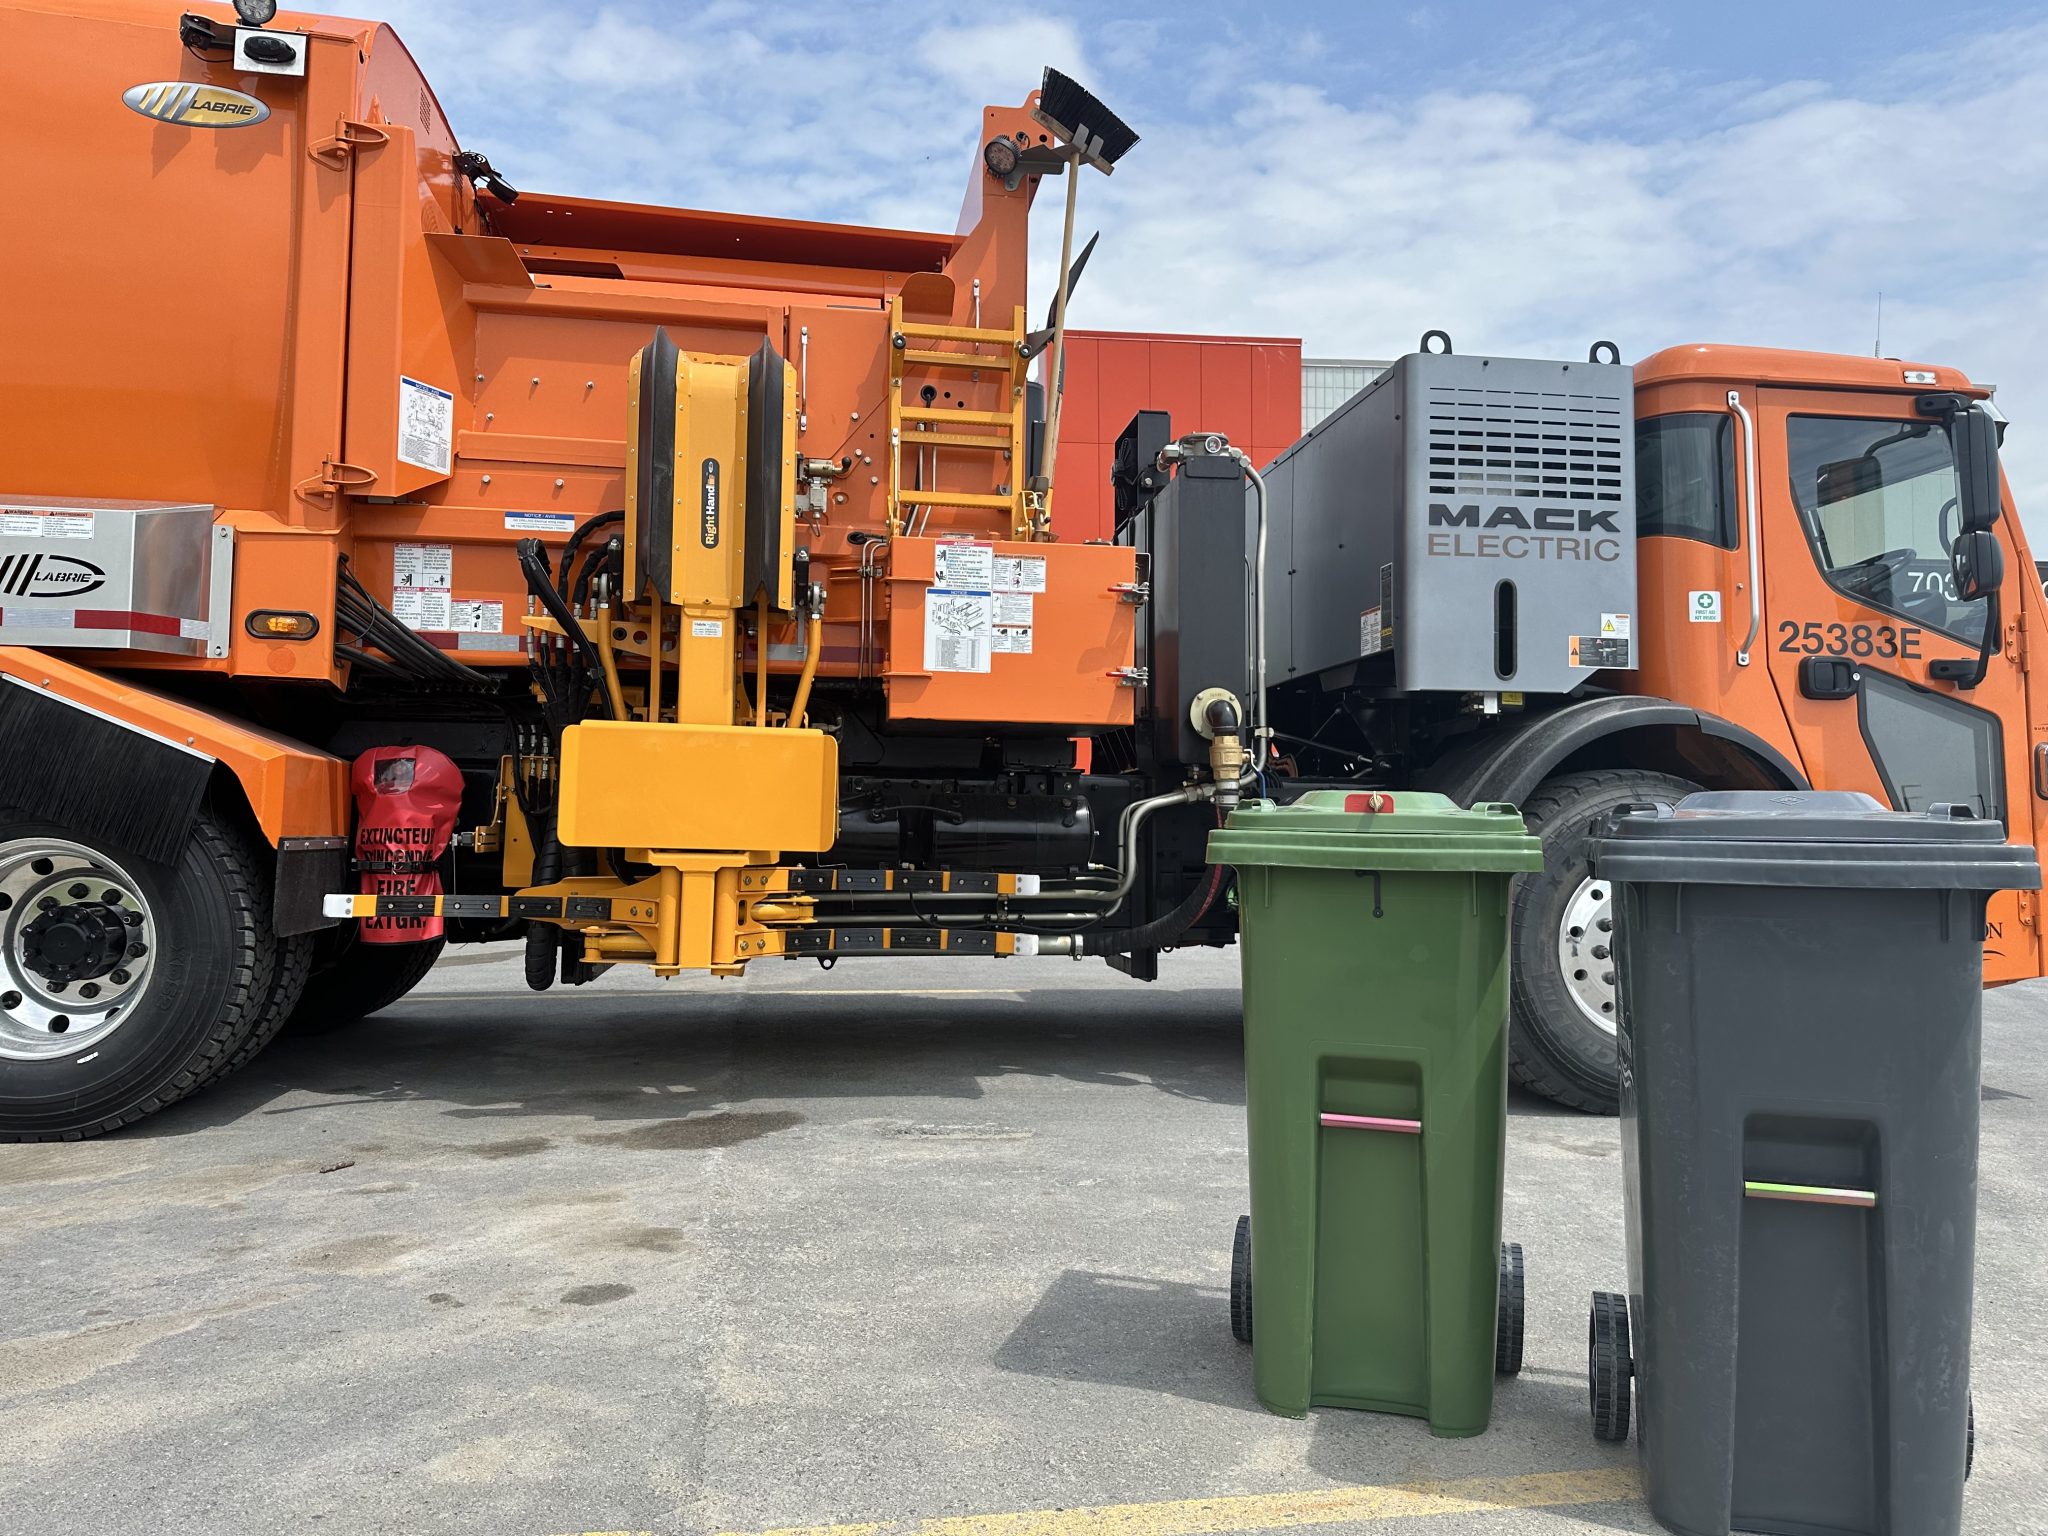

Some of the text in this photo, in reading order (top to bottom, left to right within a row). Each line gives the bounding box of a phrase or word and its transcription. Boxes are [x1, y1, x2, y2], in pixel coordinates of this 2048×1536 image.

[190, 98, 254, 116] LABRIE
[1428, 503, 1621, 533] MACK
[1427, 533, 1621, 562] ELECTRIC
[33, 571, 93, 584] LABRIE
[1778, 620, 1922, 660] 25383E
[377, 880, 416, 895] FIRE
